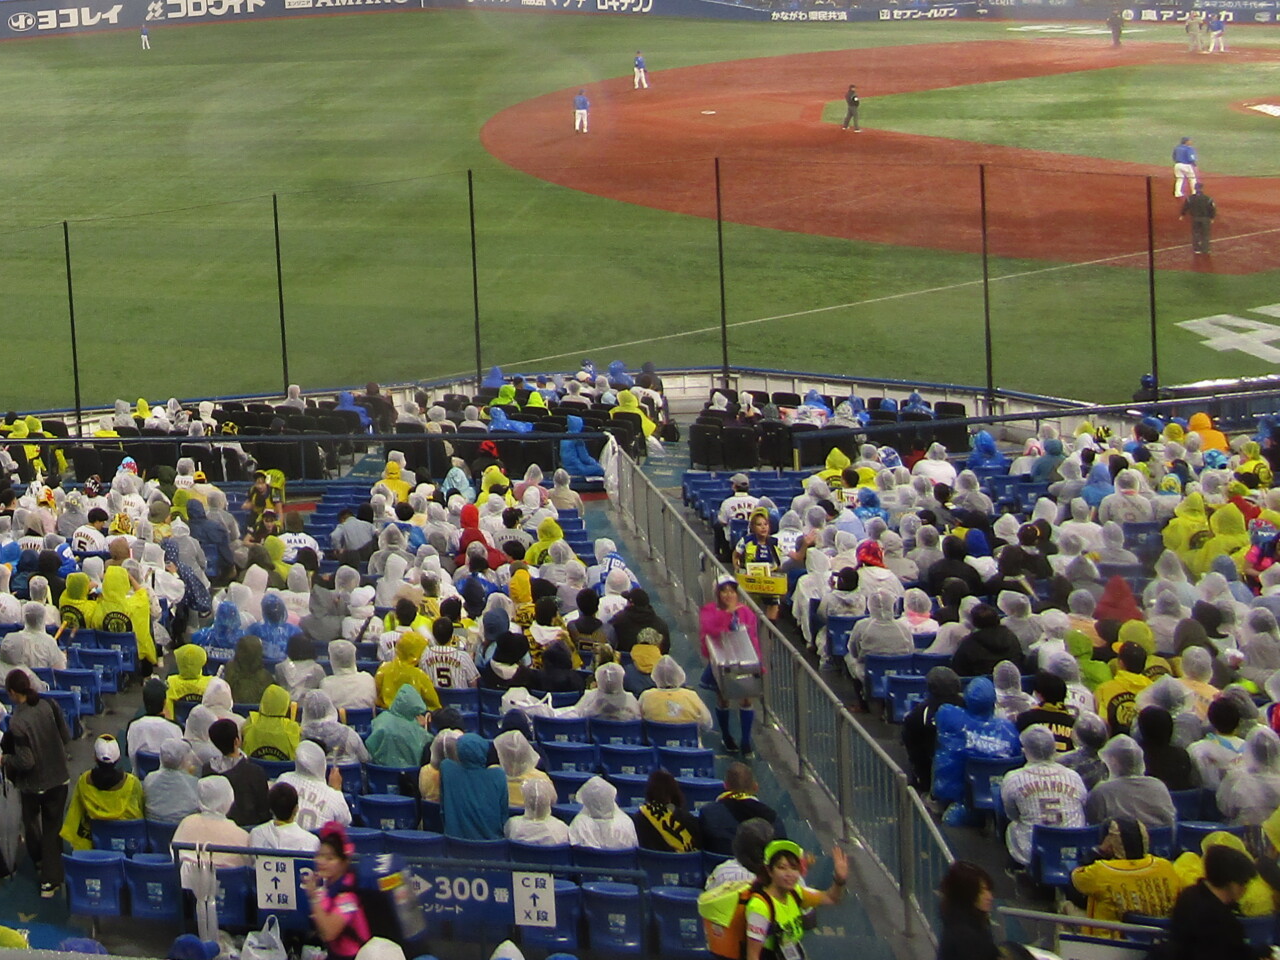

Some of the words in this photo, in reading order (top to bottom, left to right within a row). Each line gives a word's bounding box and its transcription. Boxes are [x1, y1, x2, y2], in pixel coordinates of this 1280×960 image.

[37, 4, 124, 30] ヨコレイ
[771, 10, 848, 21] かながわ県民共済
[436, 667, 453, 688] 5
[1039, 797, 1063, 823] 5
[263, 860, 287, 874] C段
[434, 876, 489, 903] 300
[521, 876, 548, 890] C段
[265, 893, 289, 905] X段
[523, 908, 550, 923] X段
